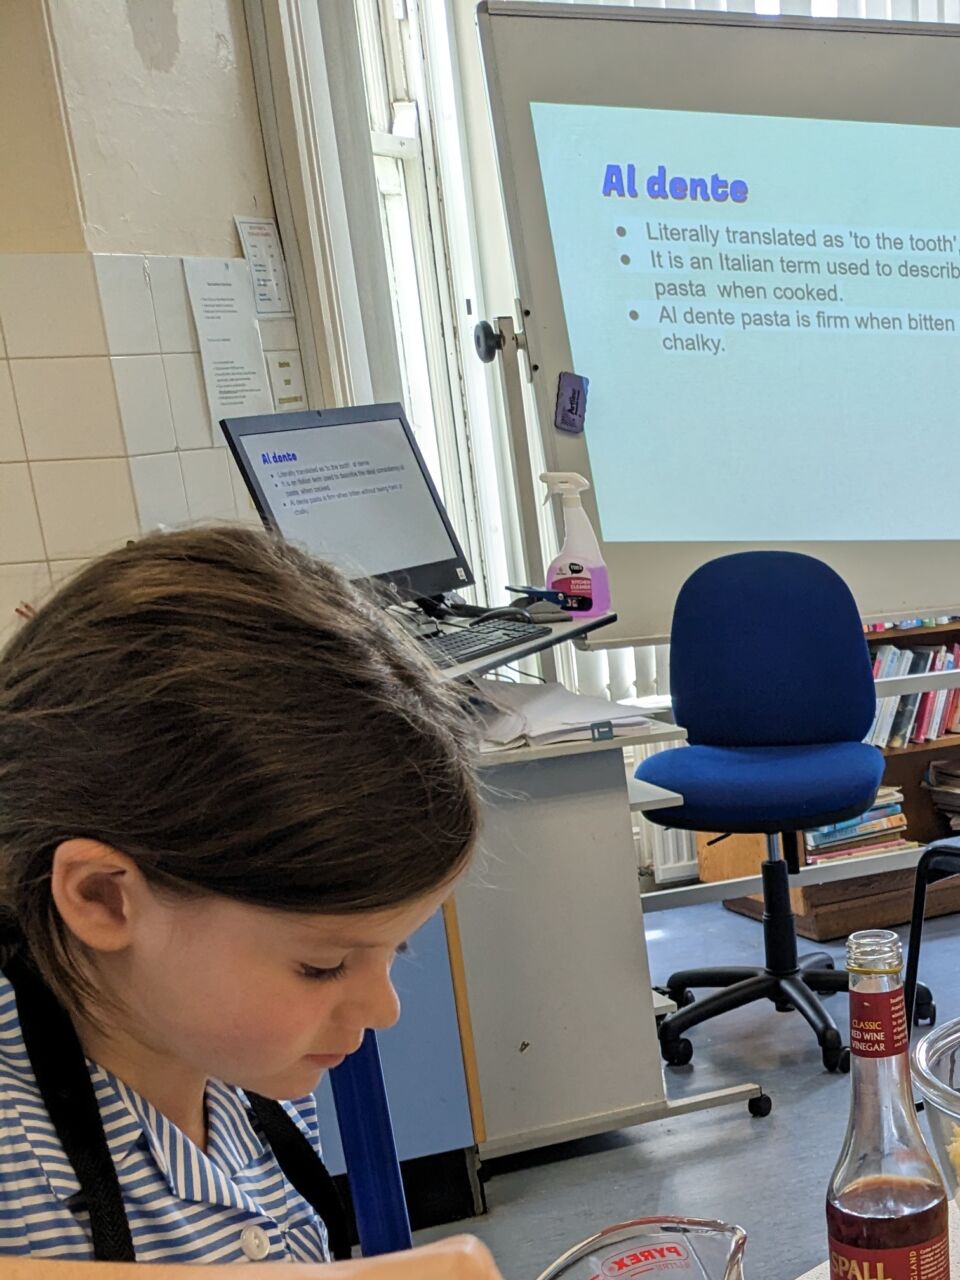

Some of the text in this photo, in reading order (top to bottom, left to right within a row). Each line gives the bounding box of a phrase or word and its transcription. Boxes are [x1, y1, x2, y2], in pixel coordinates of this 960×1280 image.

[602, 163, 749, 203] Al dente
[646, 222, 719, 247] Literally
[726, 226, 817, 247] translated
[823, 234, 844, 248] as
[876, 233, 904, 250] the
[651, 250, 663, 269] It
[668, 251, 684, 269] is
[690, 256, 713, 271] an
[719, 253, 774, 273] Italian
[780, 256, 821, 275] term
[827, 259, 870, 276] used
[876, 260, 892, 277] to
[655, 280, 843, 302] pasta when cooked.
[659, 306, 677, 324] Al
[683, 307, 735, 326] dente
[741, 311, 790, 330] pasta
[796, 310, 811, 328] is
[816, 311, 849, 329] firm
[855, 312, 902, 330] when
[908, 313, 955, 332] bitten
[662, 333, 726, 356] chalky.
[852, 1020, 882, 1030] CLASSIC
[863, 1032, 885, 1041] WINE
[852, 1040, 885, 1051] VINEGAR
